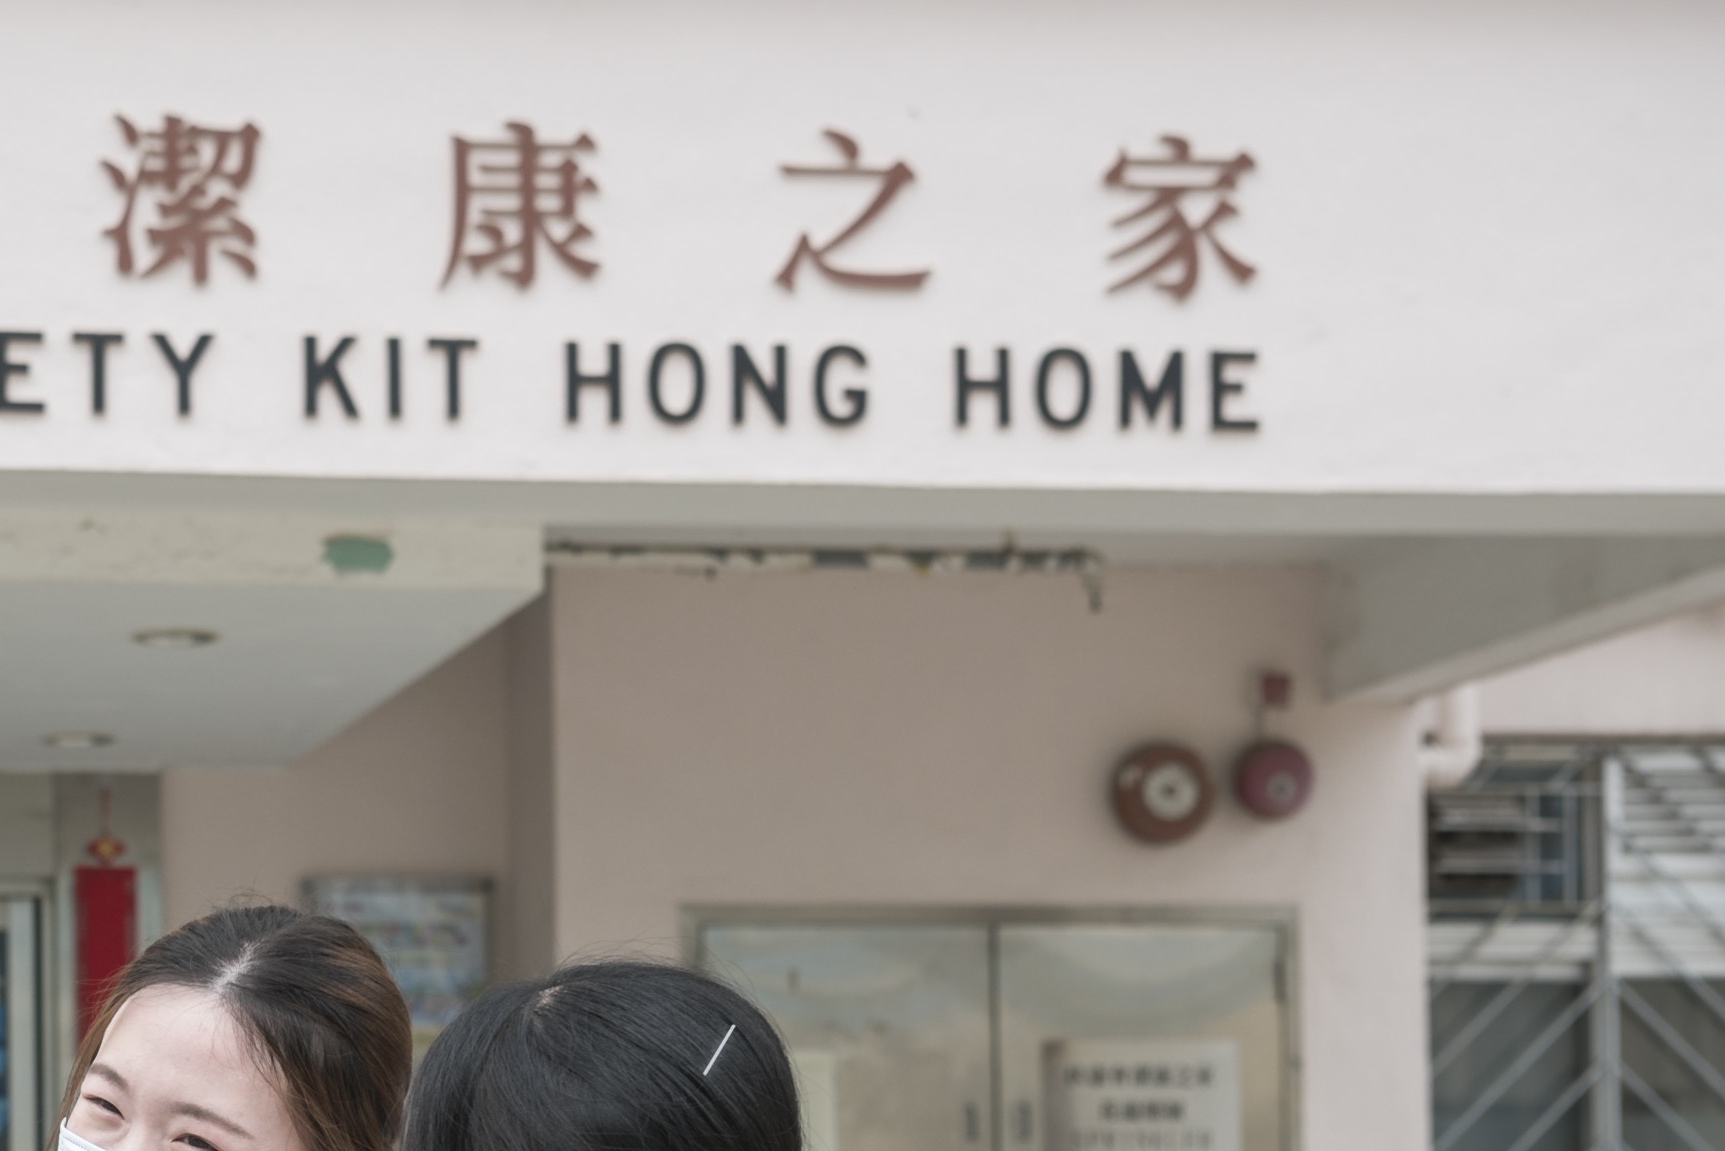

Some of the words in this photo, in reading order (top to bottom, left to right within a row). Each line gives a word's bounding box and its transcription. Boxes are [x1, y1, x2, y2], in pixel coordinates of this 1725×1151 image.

[302, 334, 480, 423] KIT
[563, 341, 868, 429] HONG
[953, 346, 1260, 433] HOME
